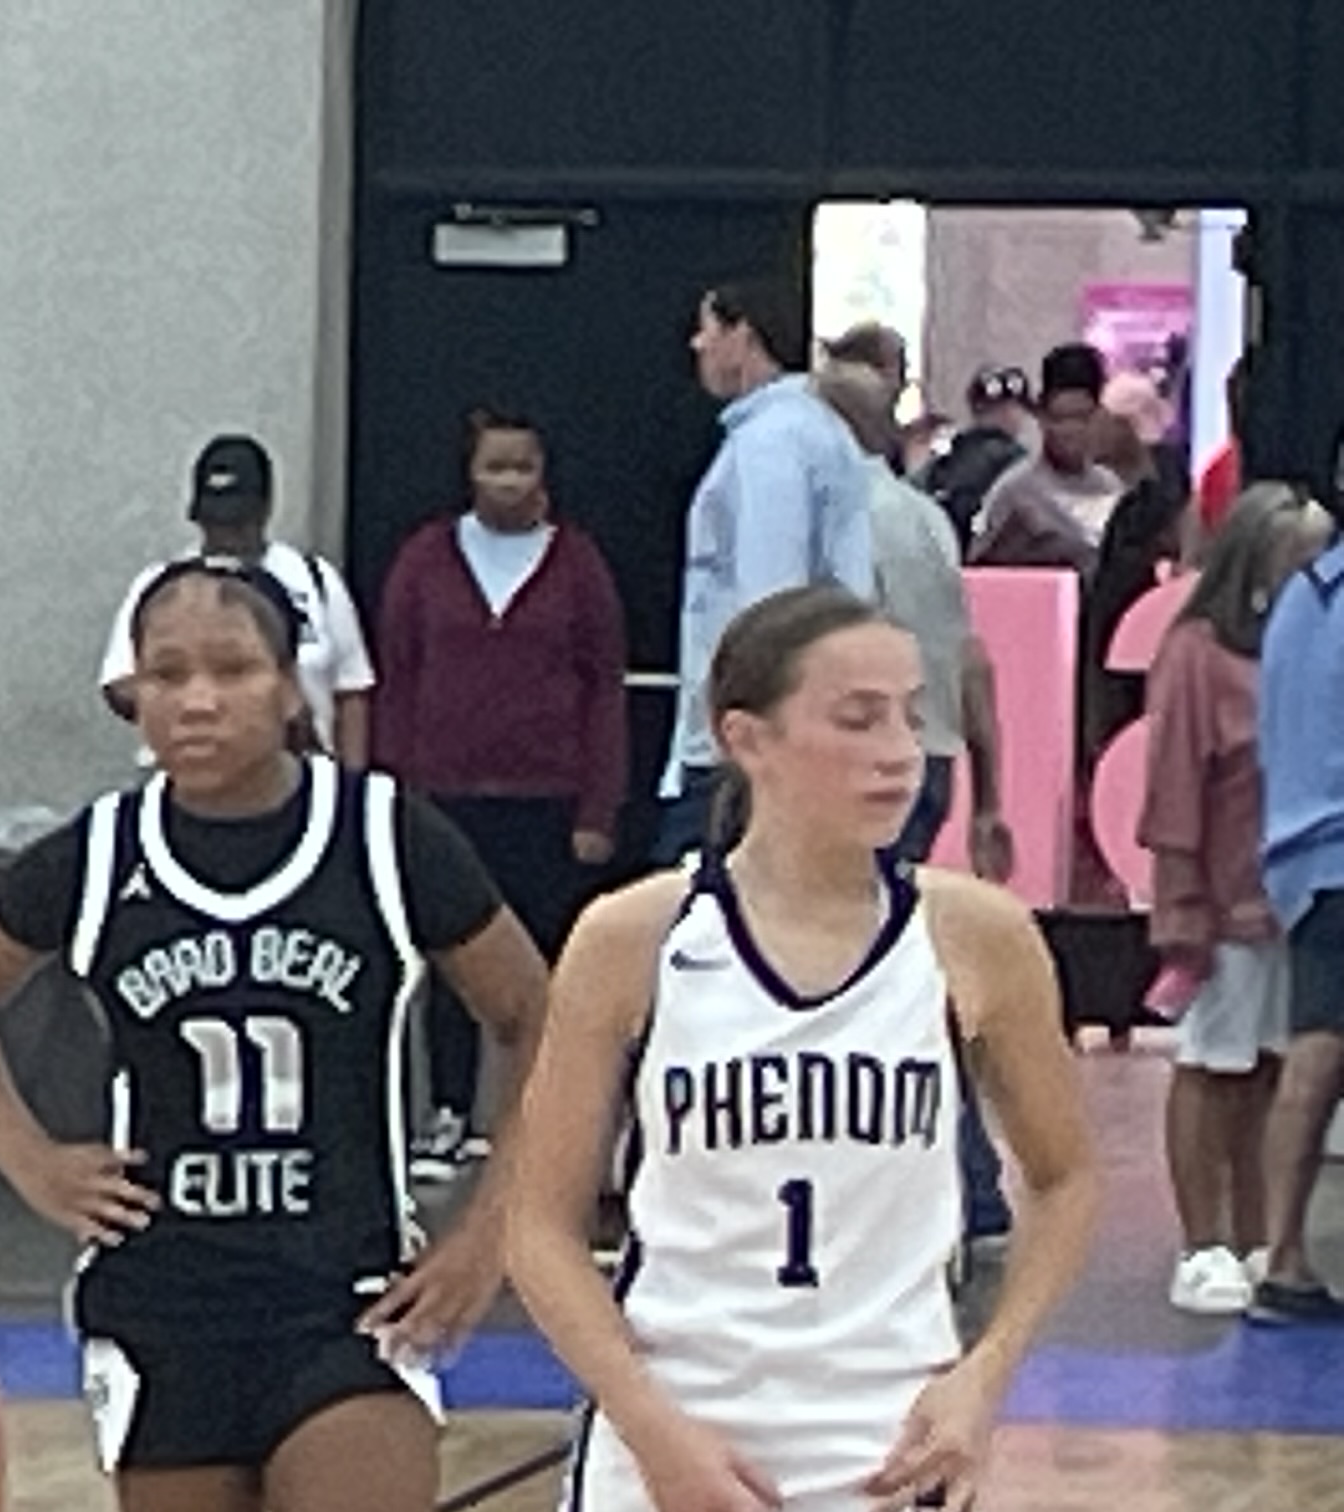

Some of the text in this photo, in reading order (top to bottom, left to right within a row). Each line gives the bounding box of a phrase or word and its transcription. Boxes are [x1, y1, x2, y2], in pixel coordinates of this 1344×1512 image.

[117, 926, 361, 1018] BRAD BEAL
[178, 1015, 303, 1133] 11
[664, 1052, 942, 1155] PHENOM
[169, 1151, 312, 1213] ELITE
[776, 1178, 819, 1288] 1
